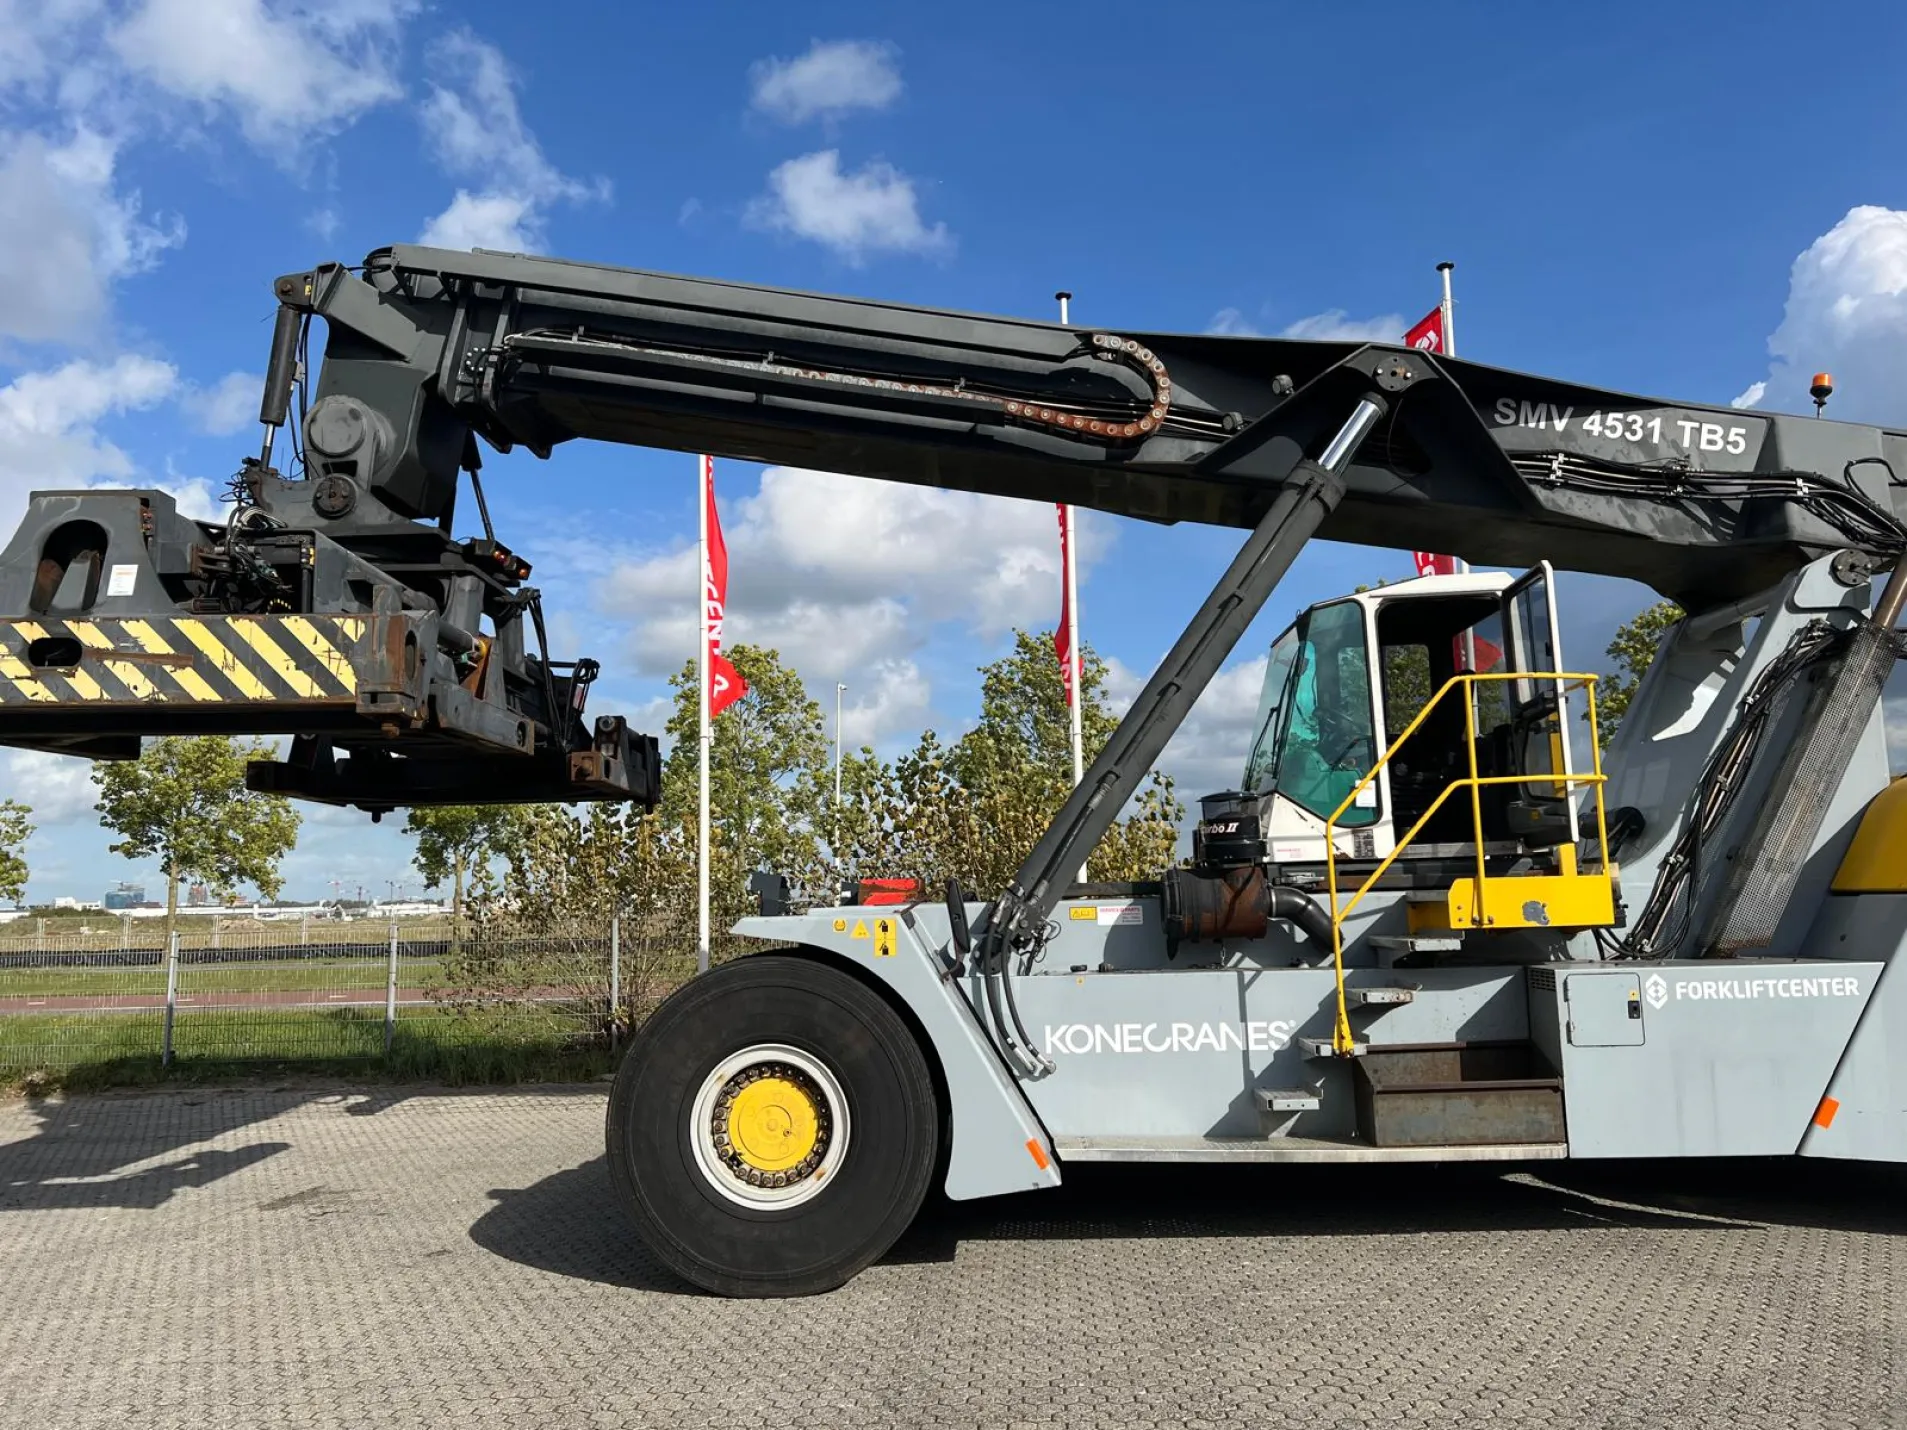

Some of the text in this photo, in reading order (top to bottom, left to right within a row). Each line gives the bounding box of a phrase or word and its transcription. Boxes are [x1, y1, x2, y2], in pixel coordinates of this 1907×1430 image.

[1494, 398, 1746, 455] SMV 4531 TB5
[1676, 977, 1860, 1000] FORKLIFTCENTER
[1045, 1020, 1292, 1054] KONECRANES
